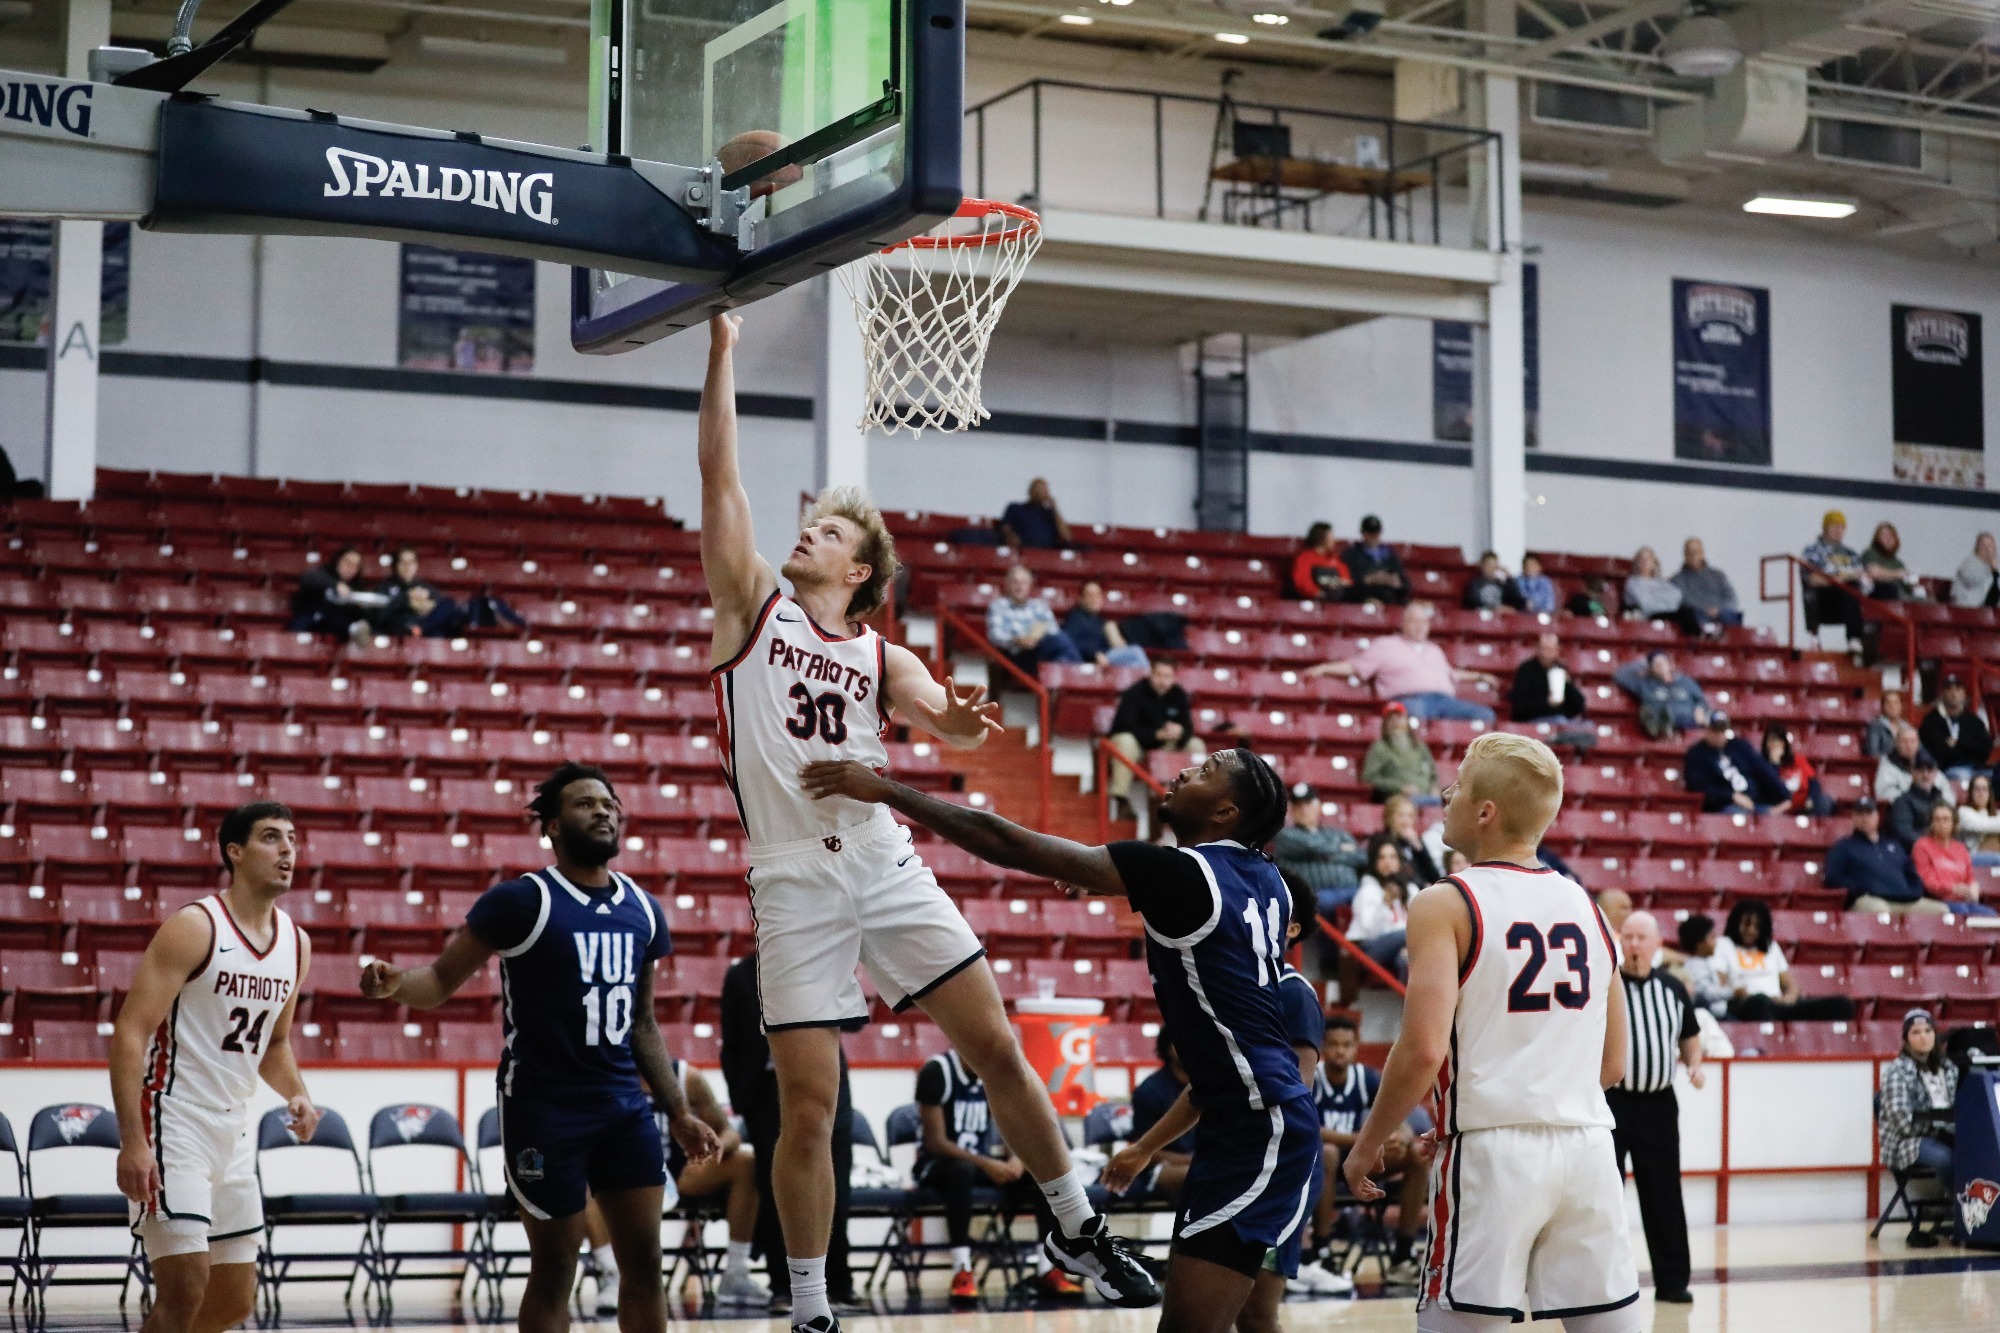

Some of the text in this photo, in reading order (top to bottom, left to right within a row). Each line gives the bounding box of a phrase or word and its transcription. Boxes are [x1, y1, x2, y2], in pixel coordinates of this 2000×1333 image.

[0, 82, 93, 138] ING
[323, 146, 554, 225] SPALDING
[59, 321, 94, 360] A
[767, 637, 871, 702] PATRIOTS
[785, 681, 848, 745] 30
[572, 931, 636, 984] VUL
[1505, 921, 1591, 1013] 23
[213, 970, 290, 1003] PATRIOTS
[221, 1006, 270, 1055] 24
[582, 985, 632, 1046] 10
[1060, 1027, 1091, 1065] G
